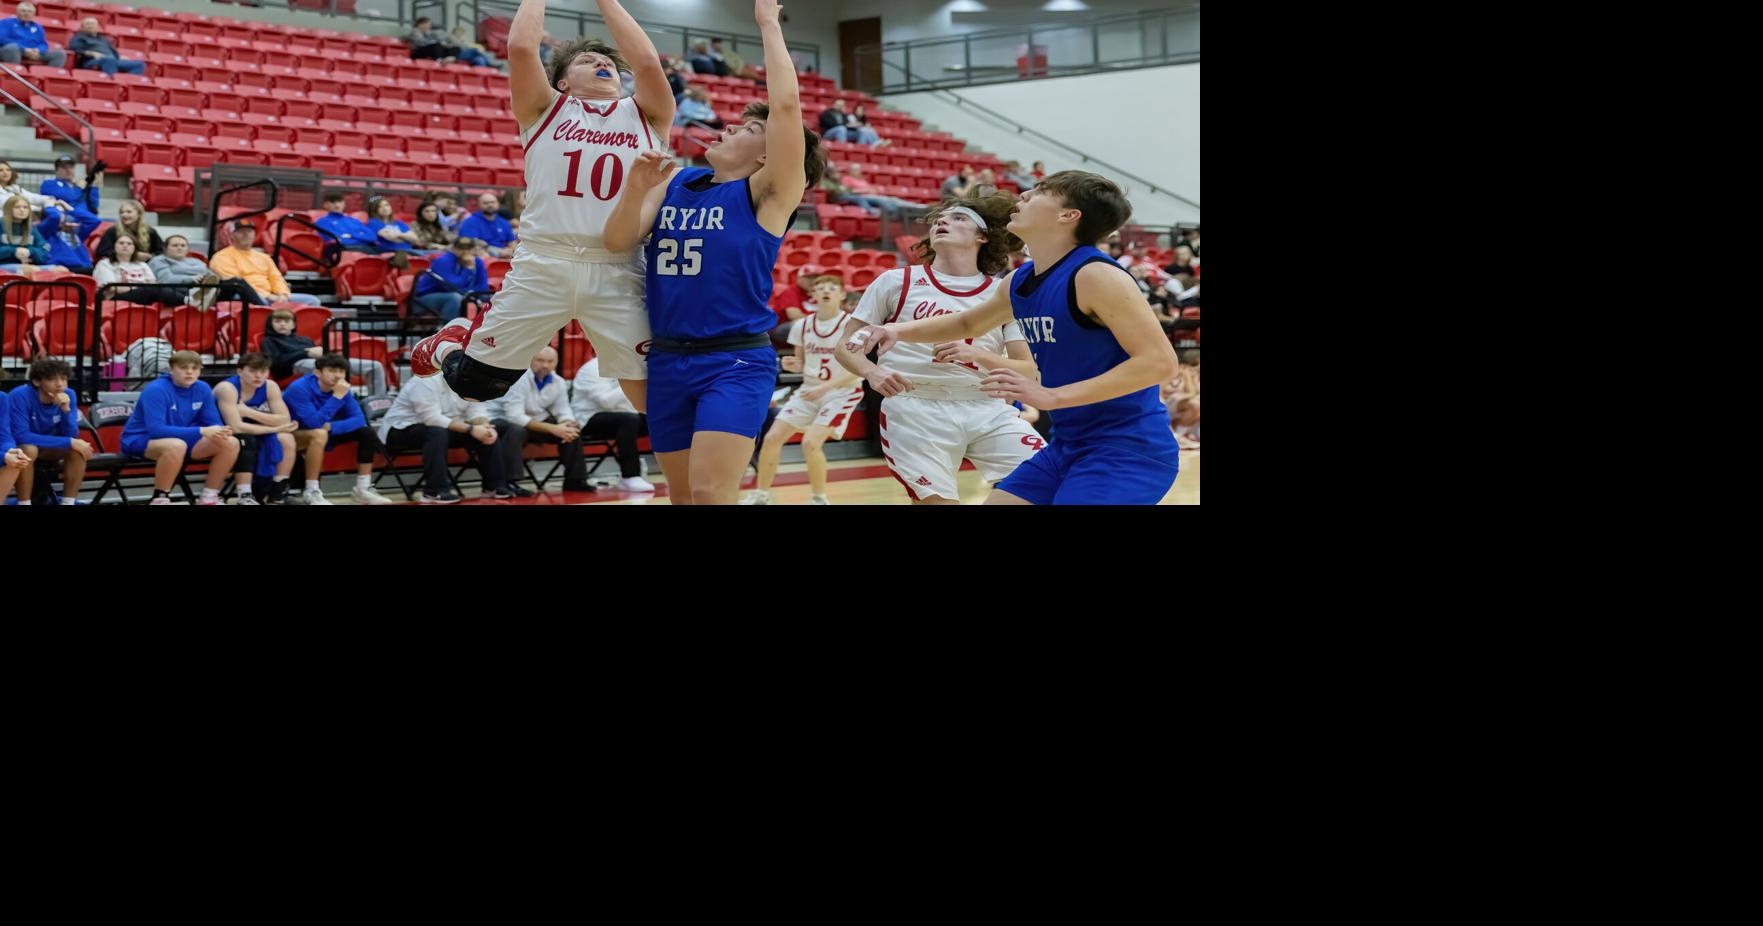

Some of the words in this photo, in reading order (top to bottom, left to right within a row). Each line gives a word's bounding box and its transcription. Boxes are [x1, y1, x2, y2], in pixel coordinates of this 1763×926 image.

[553, 119, 639, 149] Claremore
[557, 148, 624, 201] 10
[656, 238, 704, 276] 25
[818, 358, 832, 381] 5
